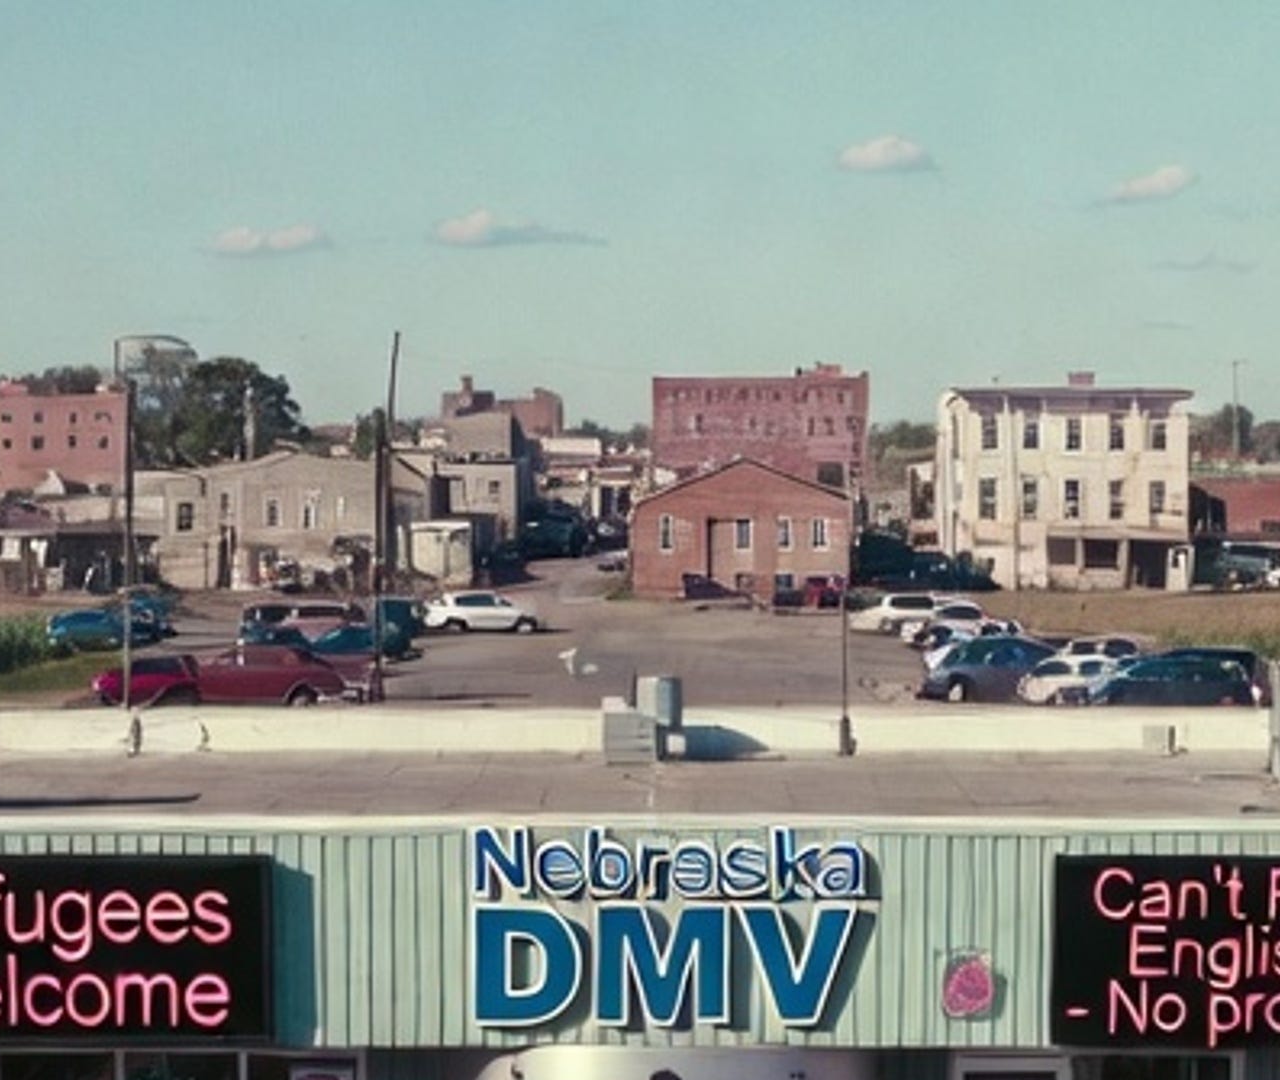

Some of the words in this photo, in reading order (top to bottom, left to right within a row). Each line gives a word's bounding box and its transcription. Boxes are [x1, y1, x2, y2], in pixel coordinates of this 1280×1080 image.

[1093, 864, 1245, 921] Can't
[473, 902, 857, 1027] DMV
[1107, 980, 1187, 1034] No
